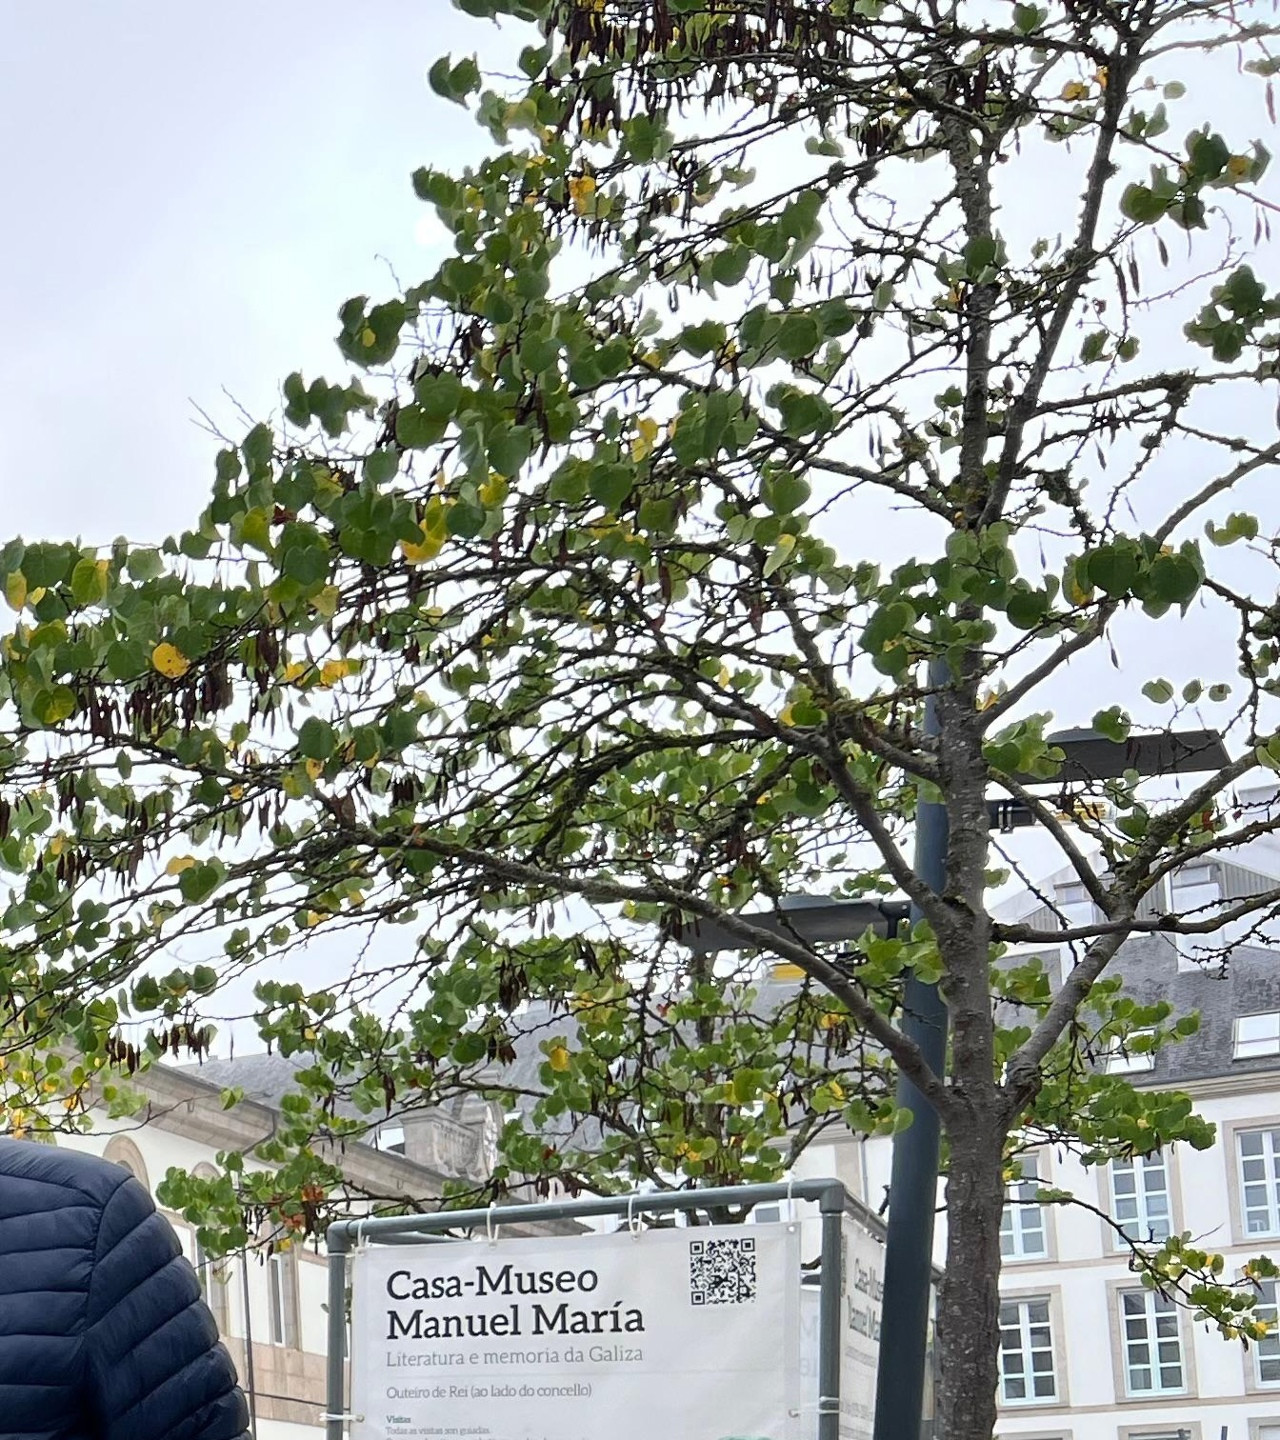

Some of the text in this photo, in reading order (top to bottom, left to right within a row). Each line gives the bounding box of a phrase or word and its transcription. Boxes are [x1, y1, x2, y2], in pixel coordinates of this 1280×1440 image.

[386, 1264, 599, 1300] Casa-Museo
[386, 1300, 646, 1340] Manuel María
[386, 1345, 644, 1367] Literatura e memoria da Galiza
[386, 1383, 593, 1400] Outeiro de Rei (ao lado do concello)
